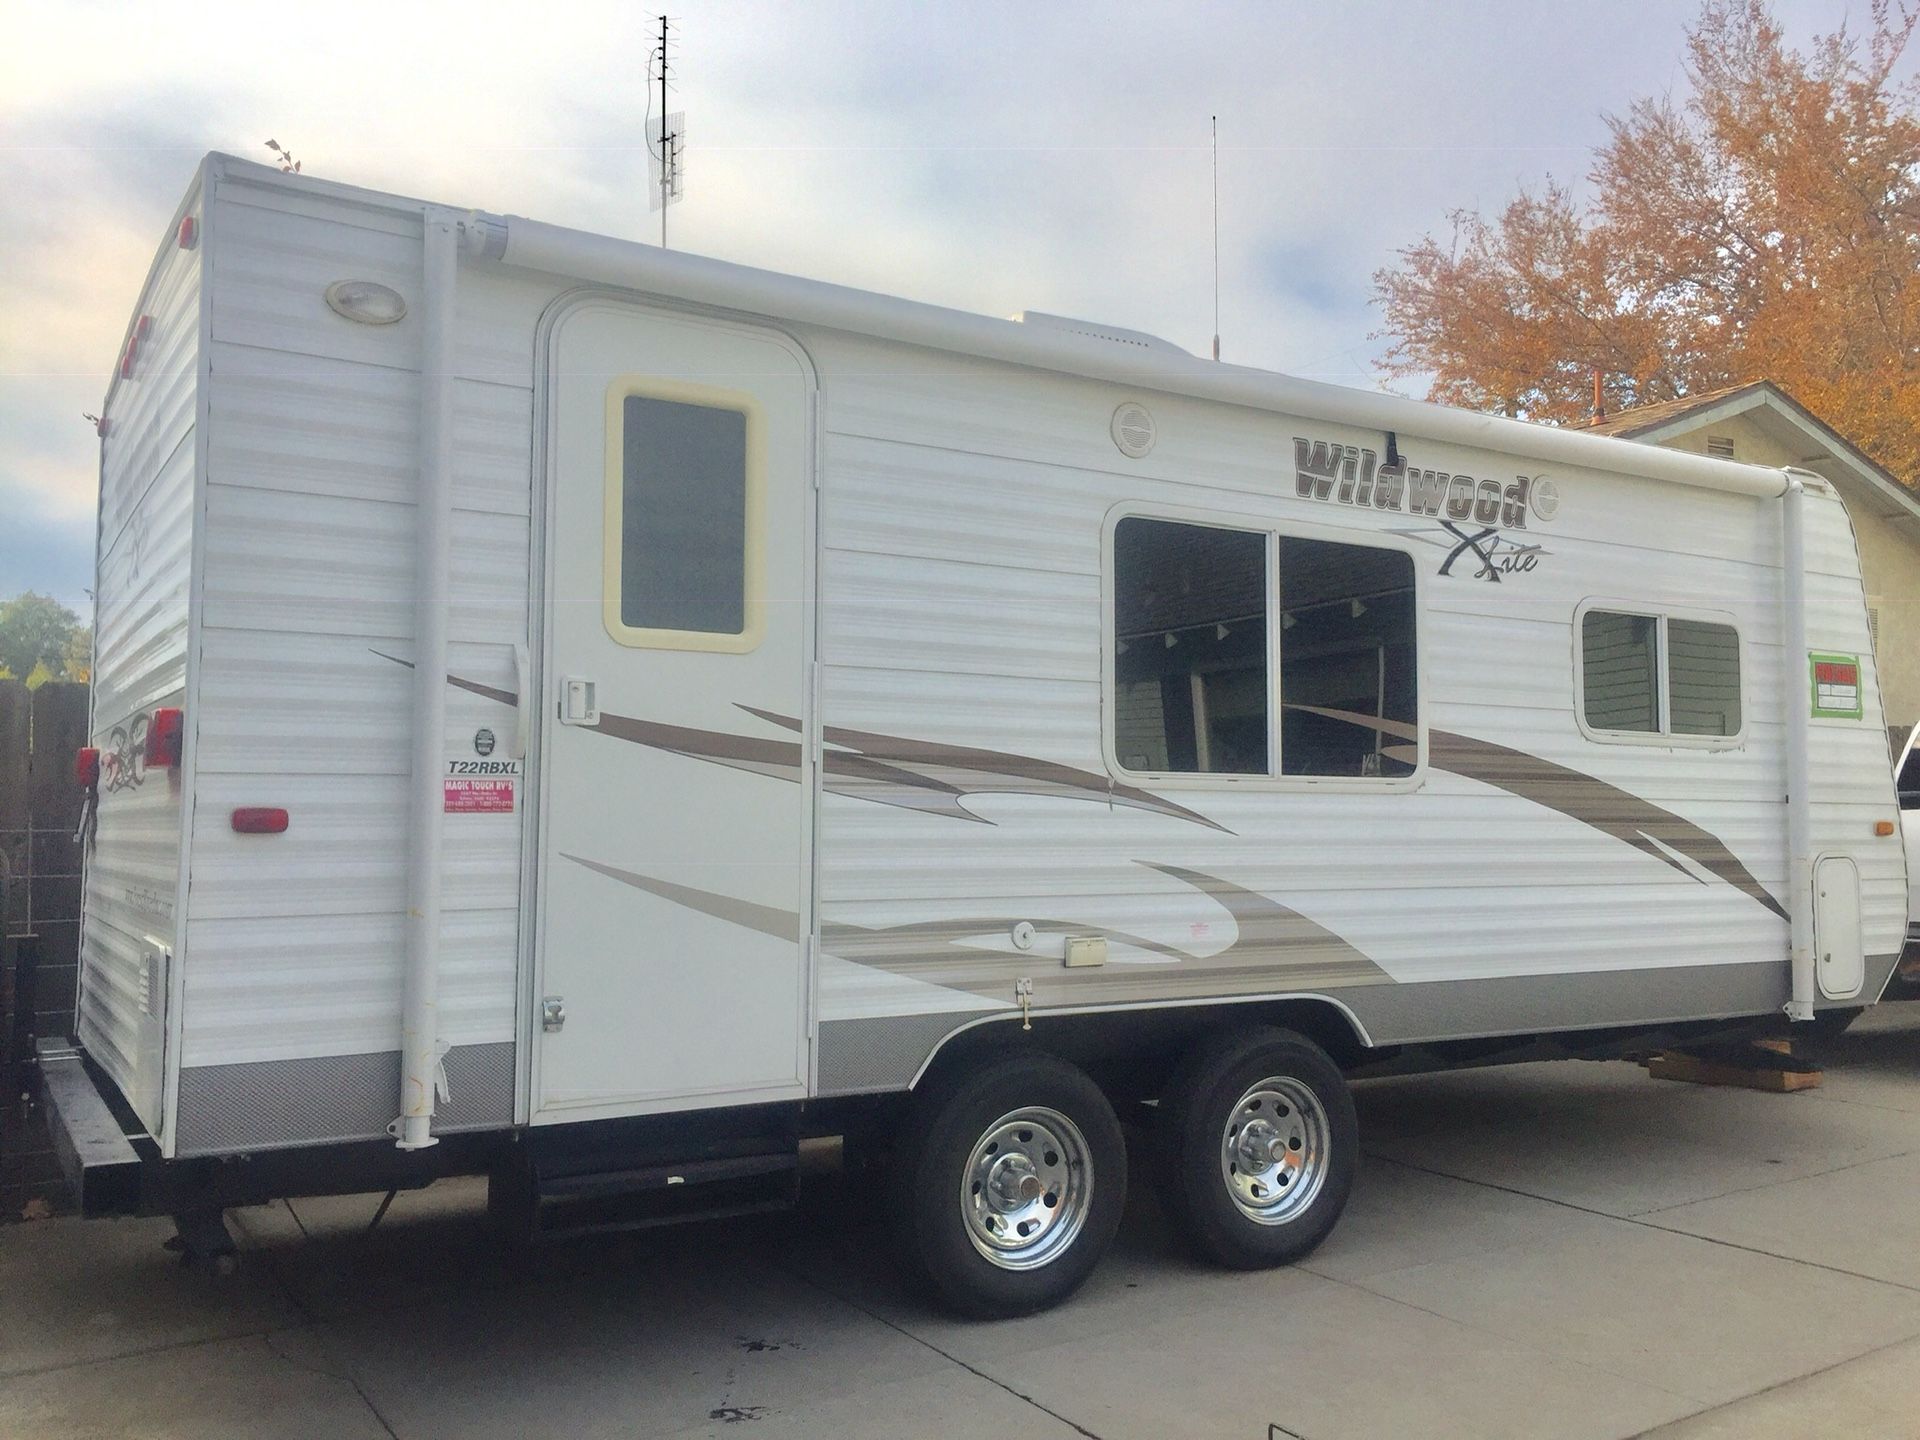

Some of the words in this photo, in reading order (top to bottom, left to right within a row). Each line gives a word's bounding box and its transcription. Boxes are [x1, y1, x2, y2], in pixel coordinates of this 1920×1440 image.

[1293, 437, 1530, 529] Wildwood
[449, 761, 519, 774] T22RBXL
[445, 781, 470, 791] MAGIC
[471, 781, 494, 791] TOUCH
